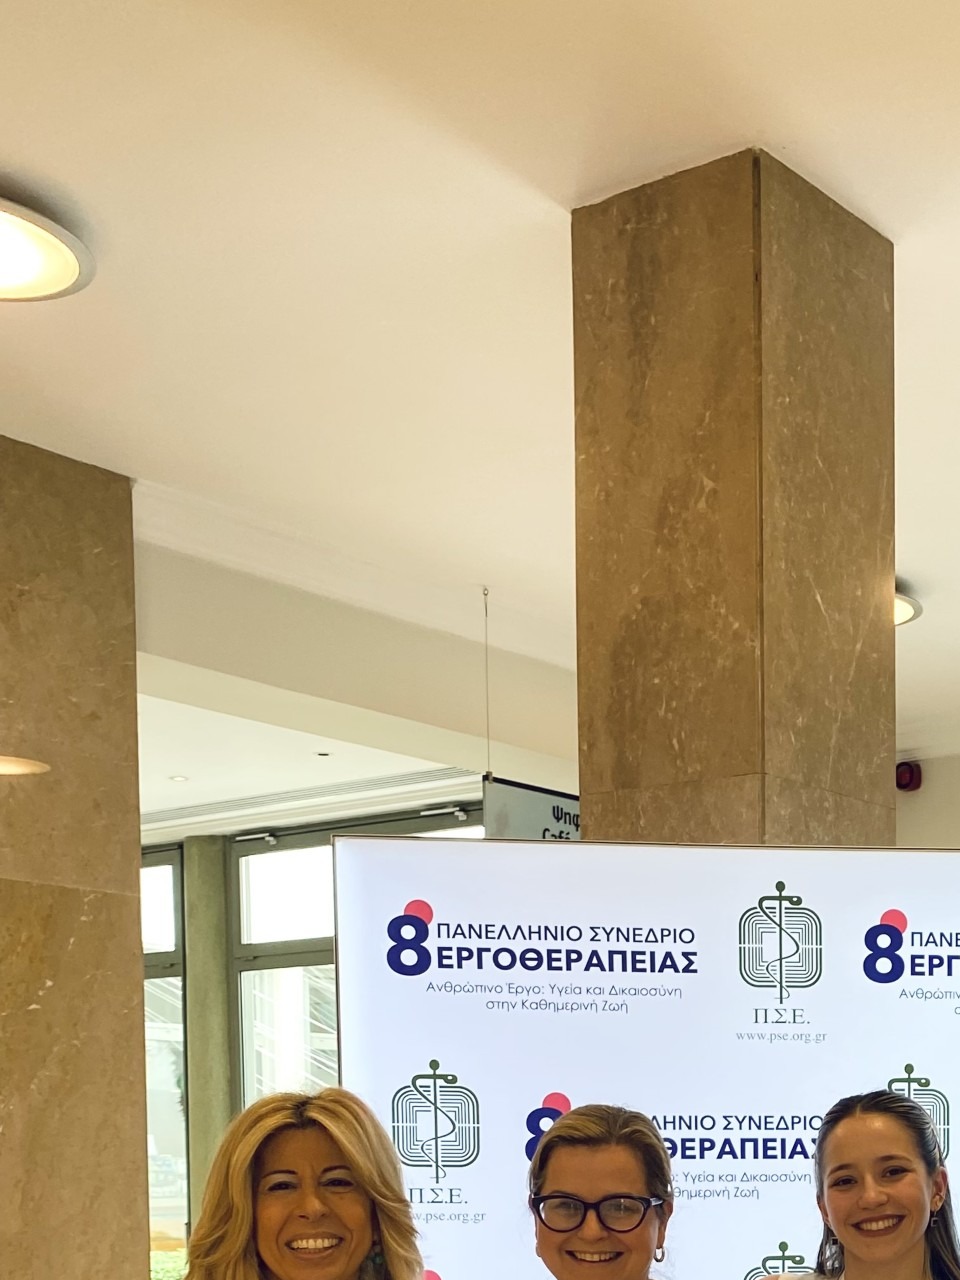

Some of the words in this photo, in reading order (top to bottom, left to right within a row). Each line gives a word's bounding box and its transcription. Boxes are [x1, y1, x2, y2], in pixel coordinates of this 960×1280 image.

[552, 805, 580, 832] Ψηφ
[386, 914, 432, 976] 8
[437, 923, 583, 942] ΠΑΝΕΛΛΗΝΙΟ
[589, 926, 696, 944] ΣΥΝΕΔΡΙΟ
[862, 923, 905, 984] 8
[437, 946, 698, 974] ΕΡΓΟΘΕΡΑΠΕΙΑΣ
[426, 981, 503, 996] Ανθρώπινο
[505, 982, 545, 997] Έργο:
[549, 983, 582, 997] Υγεία
[586, 985, 605, 996] και
[608, 984, 682, 999] Δικαιοσύνη
[486, 1000, 517, 1012] στην
[521, 999, 599, 1013] Καθημερινή
[602, 999, 629, 1014] Ζωή
[753, 1008, 810, 1024] Π.Σ.Ε.
[736, 1031, 828, 1044] www.pse.org.gr
[651, 1115, 717, 1131] ΛΗΝΙΟ
[722, 1115, 824, 1131] ΣΥΝΕΔΡΙΟ
[662, 1137, 819, 1160] ΘΕΡΑΠΕΙΑ
[682, 1171, 715, 1185] Υγεία
[718, 1173, 737, 1182] και
[740, 1171, 812, 1185] Δικαιοσύνη
[408, 1187, 468, 1204] Π.Σ.Ε.
[673, 1186, 730, 1200] θημερινή
[734, 1186, 760, 1200] Ζωή
